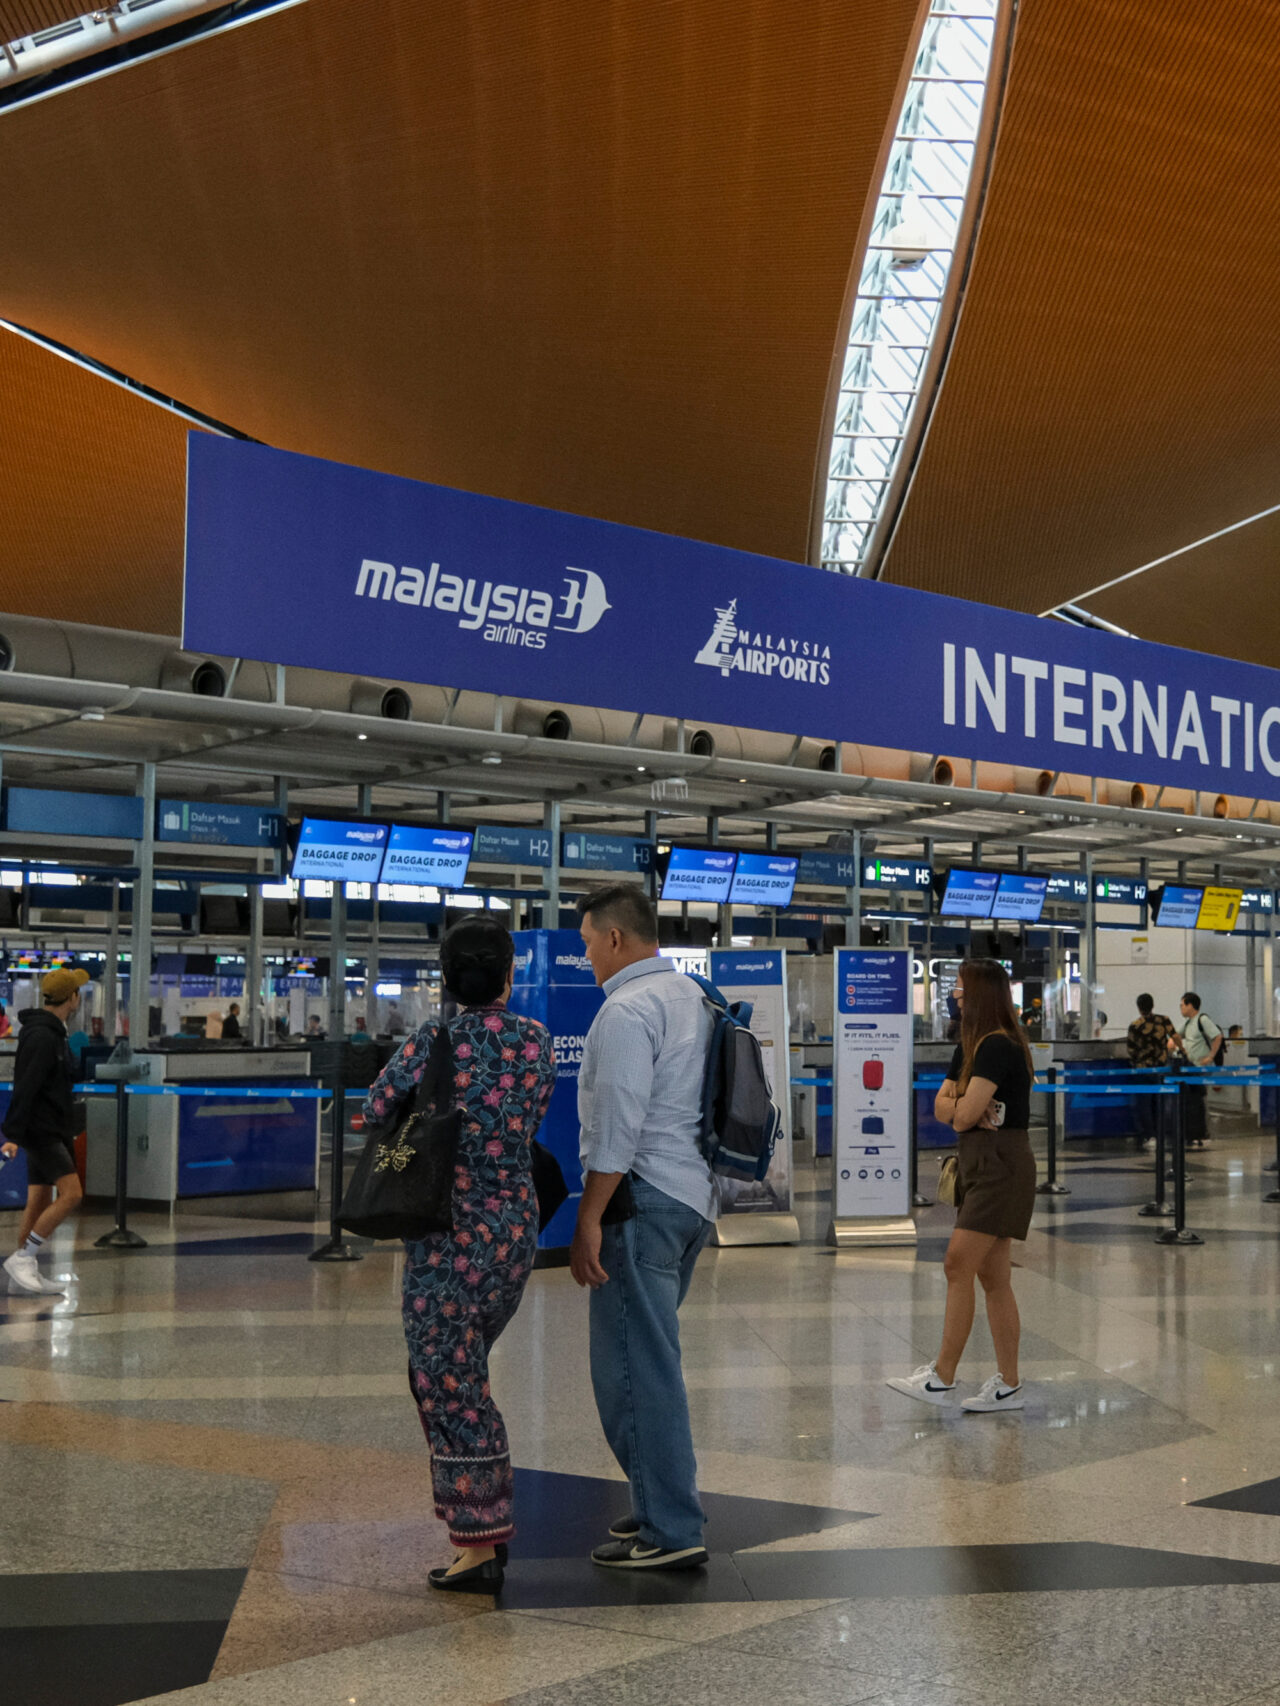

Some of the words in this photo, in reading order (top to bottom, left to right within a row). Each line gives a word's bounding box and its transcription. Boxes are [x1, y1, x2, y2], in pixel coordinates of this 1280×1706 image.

[355, 559, 553, 631] malaysia
[483, 623, 547, 650] airlines
[738, 629, 831, 660] MALAYSIA
[730, 647, 830, 686] AIRPORTS
[258, 817, 279, 837] H1
[302, 849, 349, 861] BAGGAGE
[351, 852, 377, 862] DROP
[529, 839, 549, 857] H2
[390, 855, 436, 866] BAGGAGE
[437, 858, 462, 868] DROP
[633, 848, 650, 864] H3
[837, 862, 853, 877] H4
[915, 868, 930, 884] H5
[670, 874, 706, 884] BAGGAGE
[707, 876, 728, 885] DROP
[736, 878, 770, 888] BAGGAGE
[771, 880, 790, 889] DROP
[1074, 880, 1087, 895] H6
[1134, 886, 1146, 899] H7
[553, 1036, 584, 1049] ECON
[554, 1051, 582, 1064] CLAS
